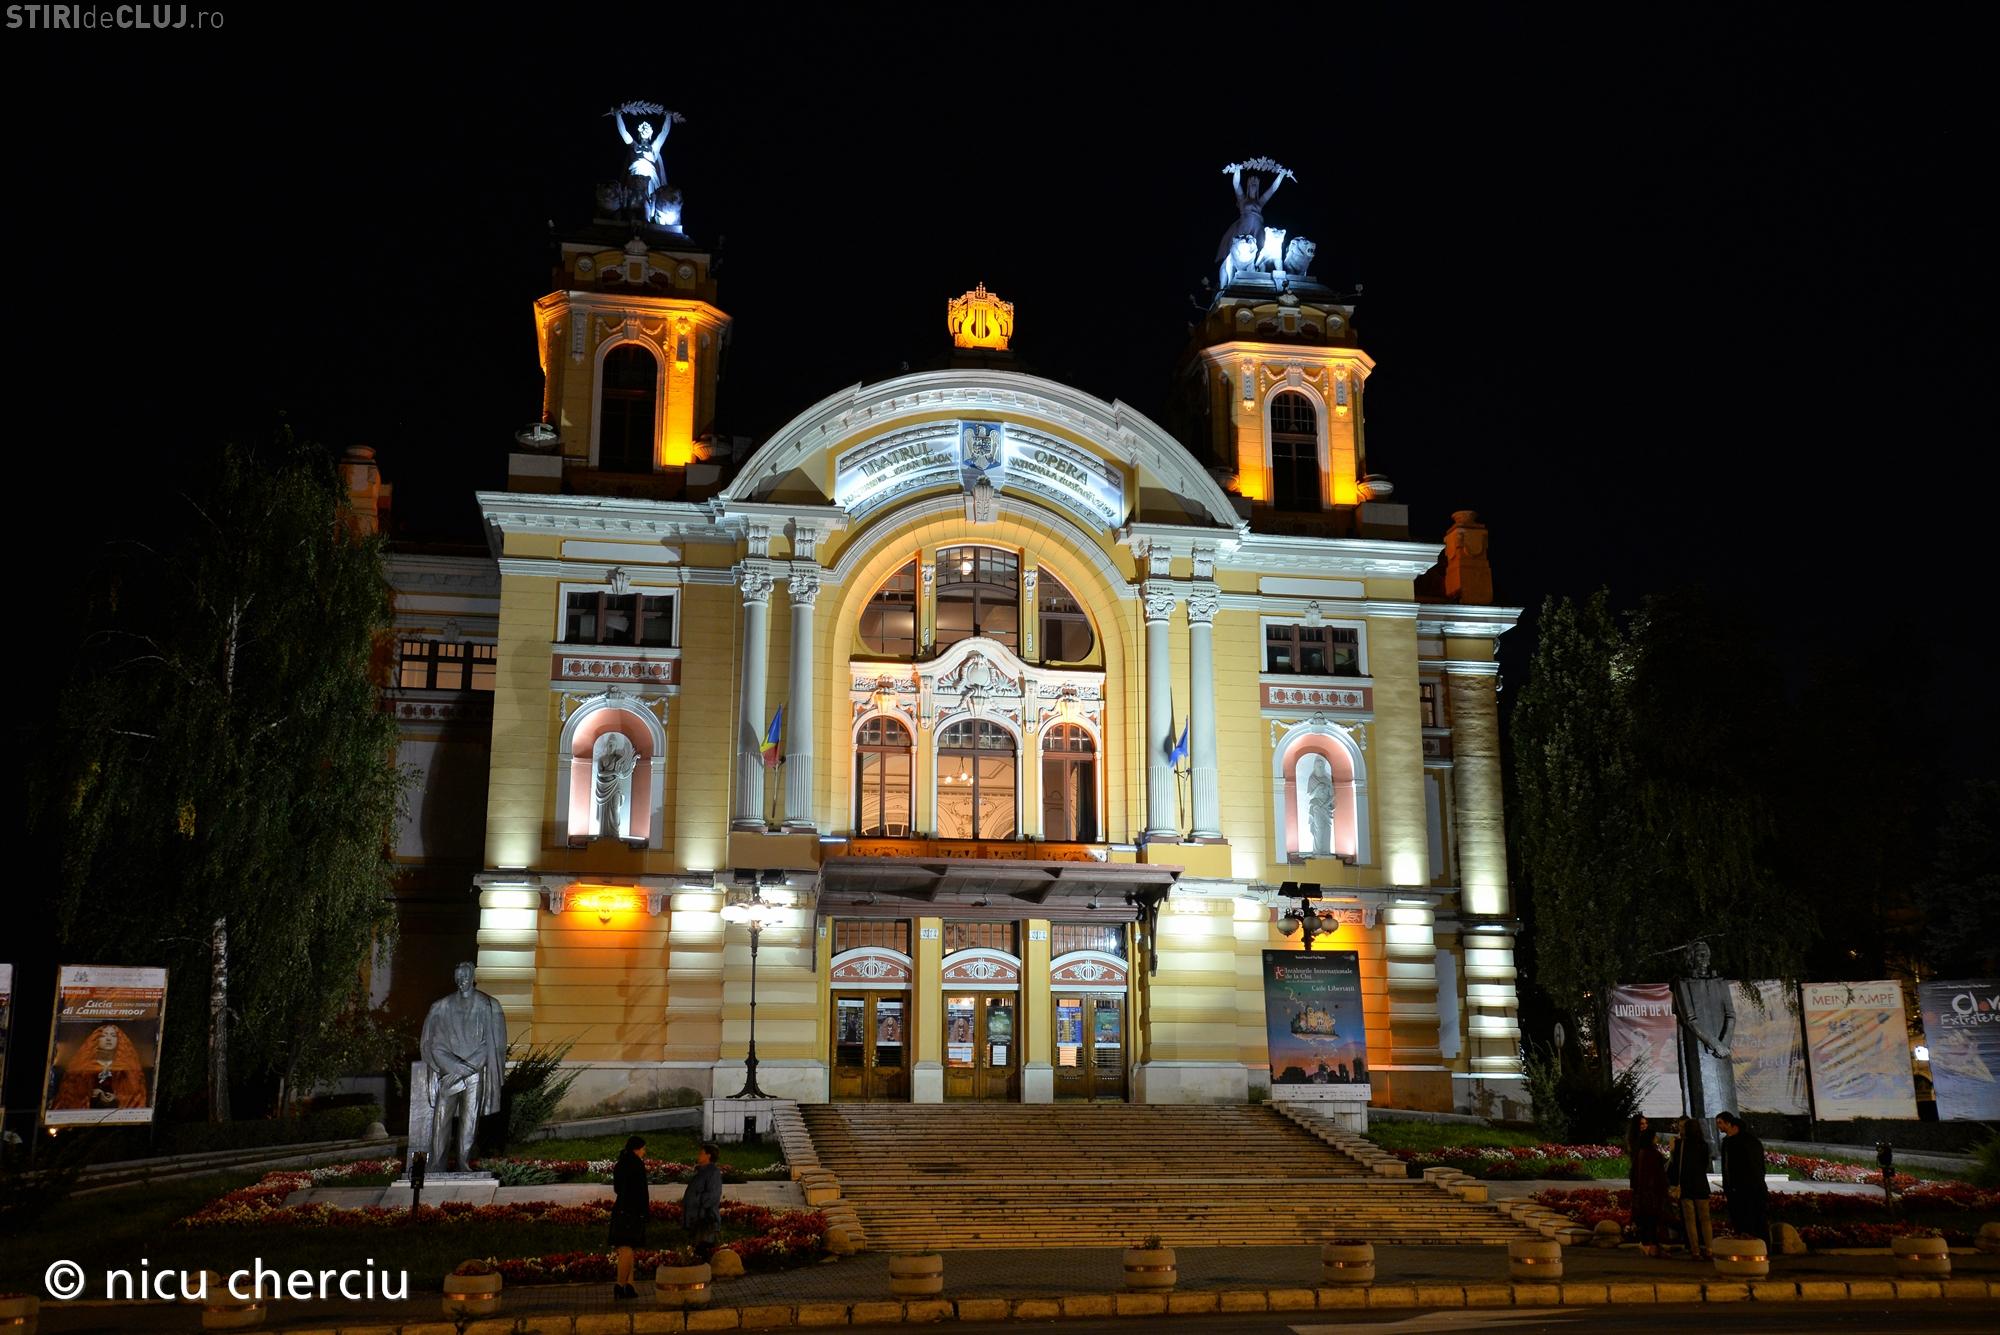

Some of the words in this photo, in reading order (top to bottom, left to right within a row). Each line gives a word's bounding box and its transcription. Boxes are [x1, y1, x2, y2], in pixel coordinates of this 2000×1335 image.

[858, 441, 932, 477] TEATRUL
[1034, 449, 1088, 486] OPERA
[84, 999, 113, 1008] Lucia
[1812, 994, 1844, 1006] MEIN
[62, 1007, 73, 1015] di
[75, 1006, 146, 1016] Lammermoor
[1615, 1004, 1647, 1017] LIVADA
[1649, 1004, 1661, 1017] DE
[1663, 1004, 1673, 1017] VI
